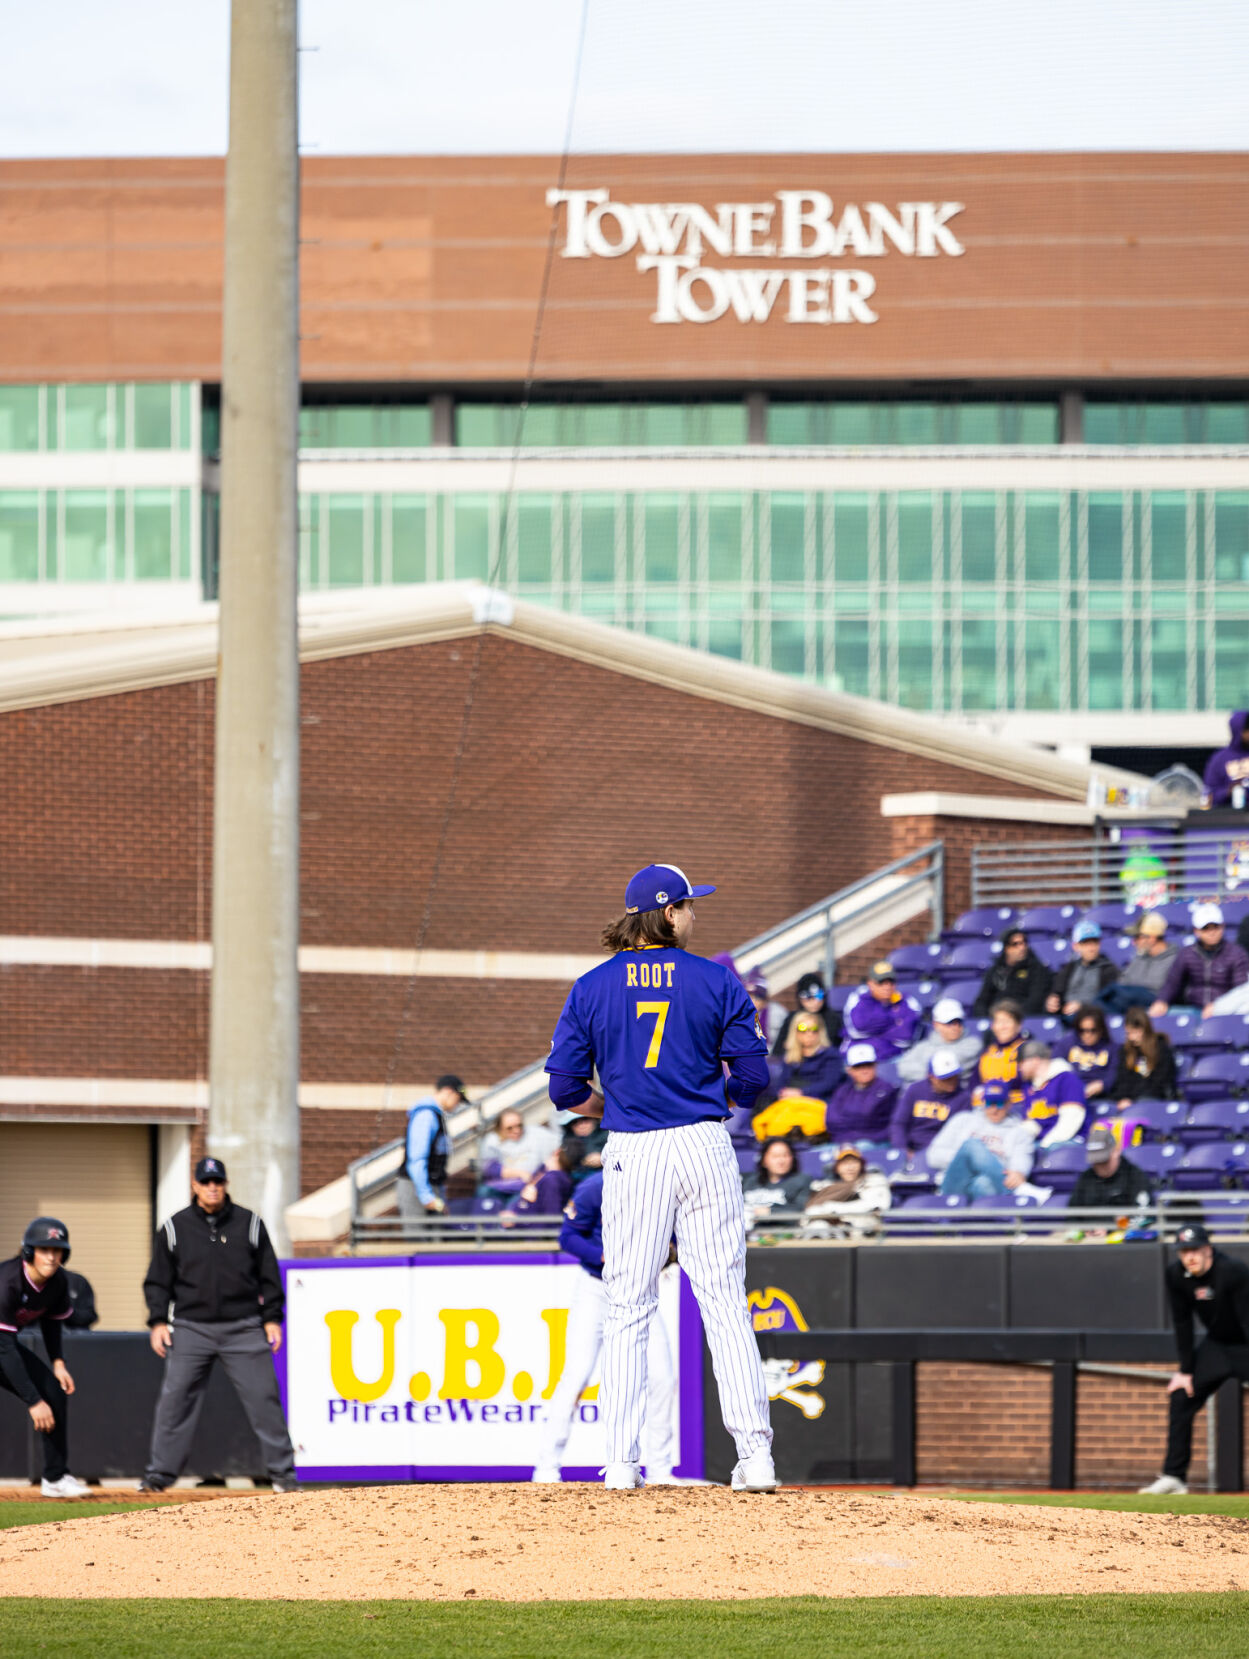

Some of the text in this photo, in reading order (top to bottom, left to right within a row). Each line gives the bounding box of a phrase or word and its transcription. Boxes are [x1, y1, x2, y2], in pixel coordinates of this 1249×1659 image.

[636, 255, 878, 325] TOWER
[626, 962, 676, 988] ROOT
[636, 1001, 670, 1068] 7
